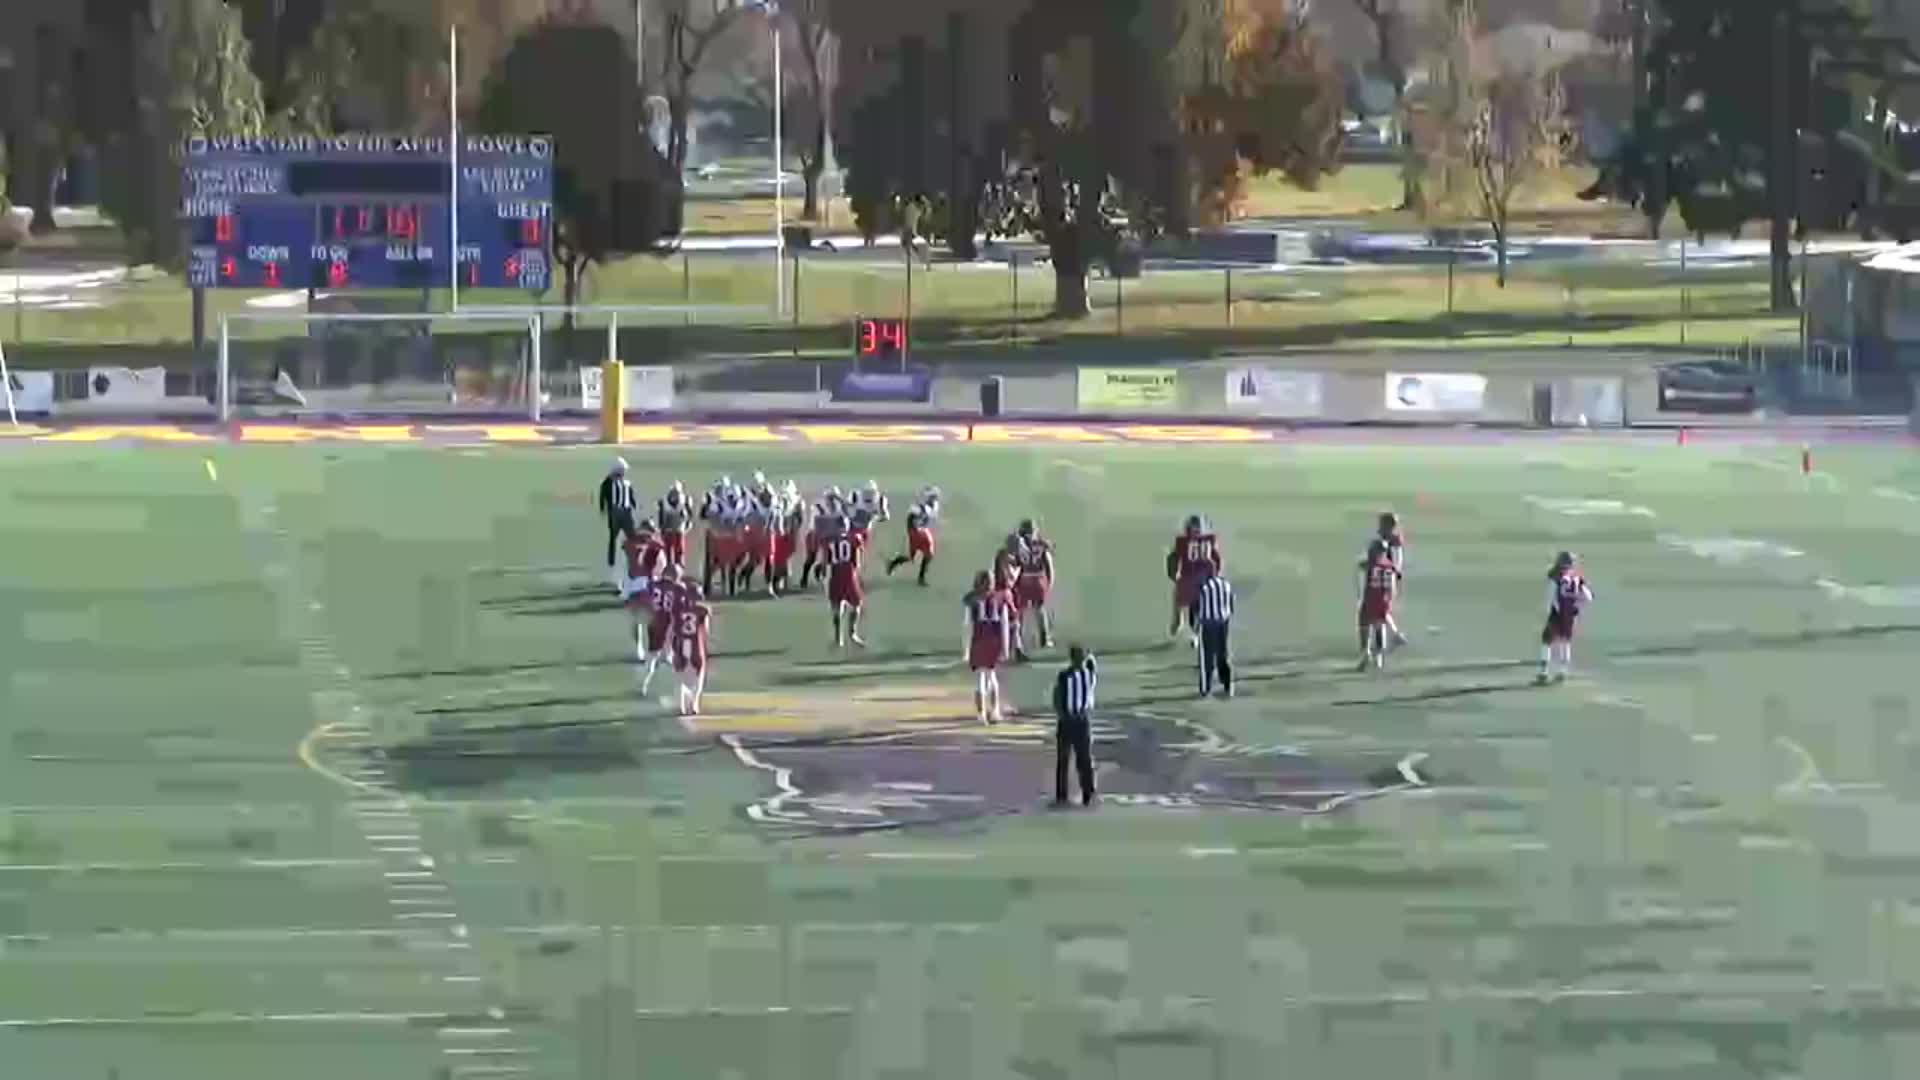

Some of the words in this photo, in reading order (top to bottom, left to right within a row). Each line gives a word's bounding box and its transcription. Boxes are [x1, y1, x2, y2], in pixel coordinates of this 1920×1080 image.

[184, 200, 233, 217] HOME
[247, 245, 289, 260] DOWN
[862, 320, 901, 352] 34
[635, 543, 649, 566] 7
[829, 540, 851, 563] 10
